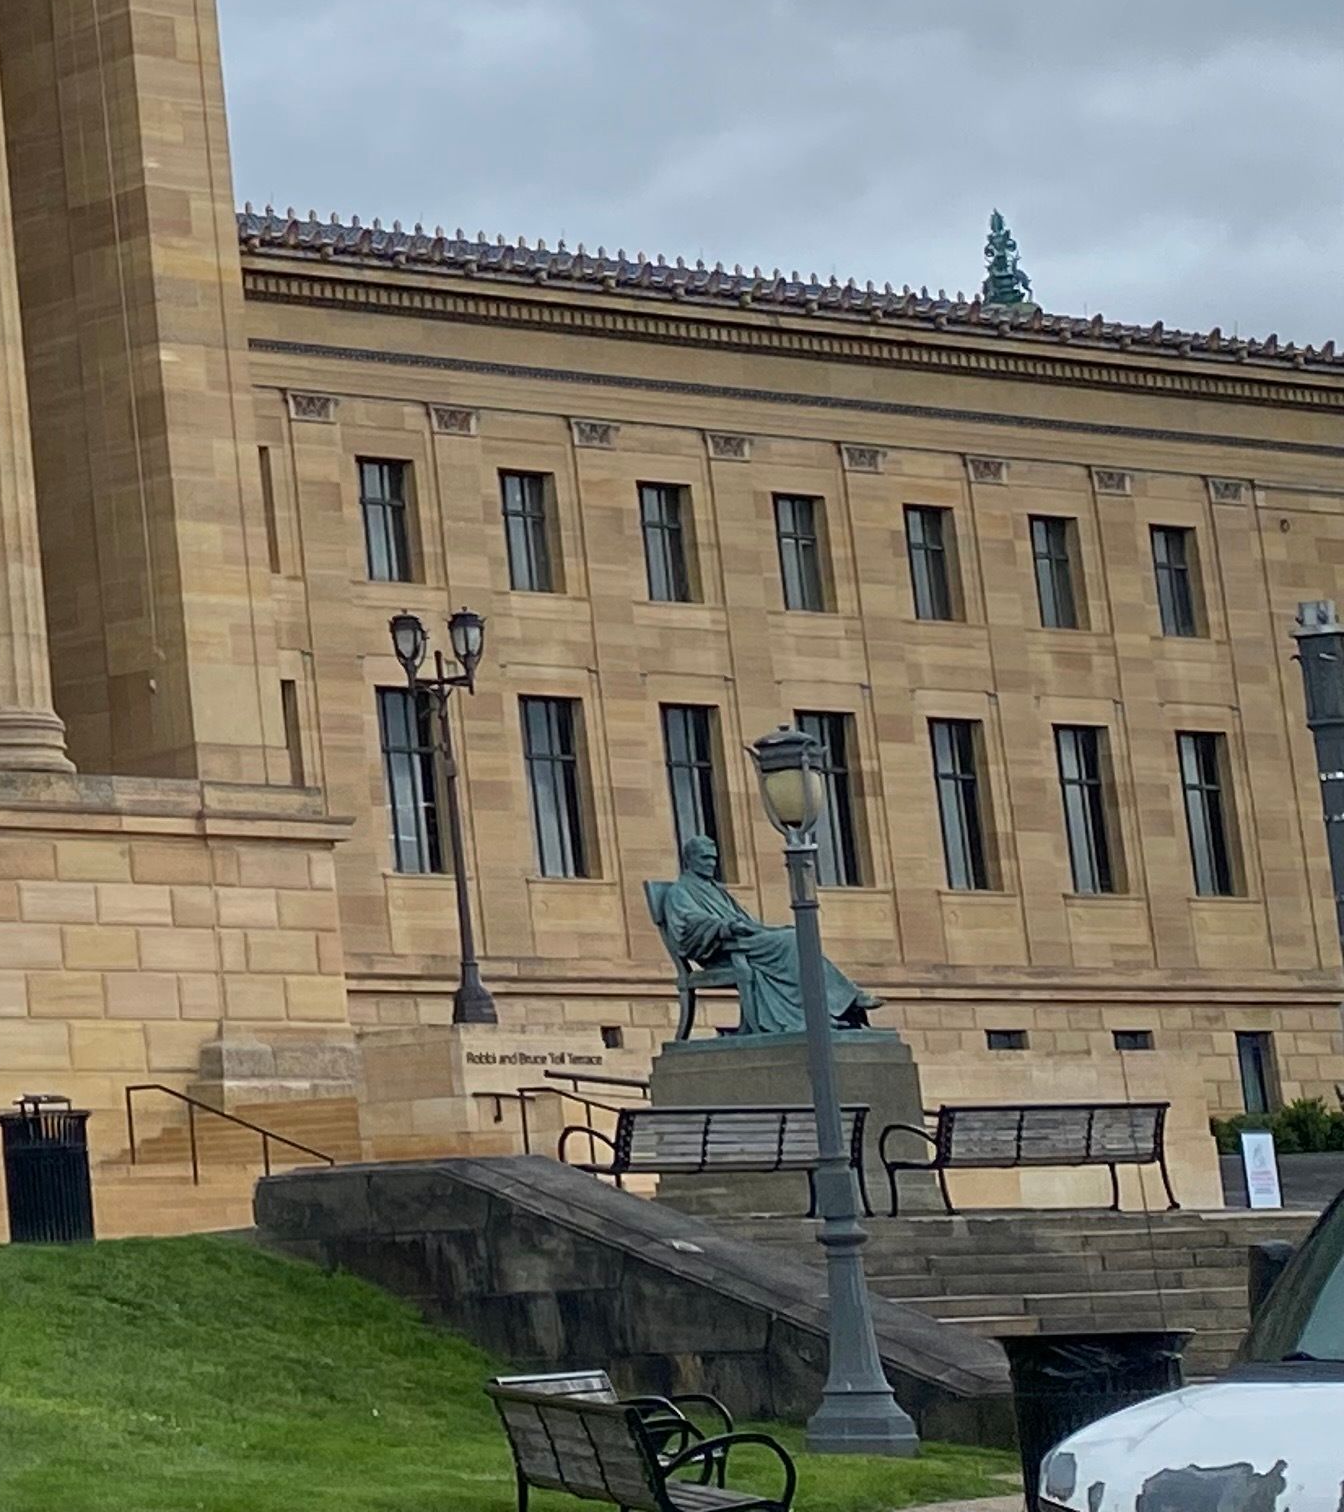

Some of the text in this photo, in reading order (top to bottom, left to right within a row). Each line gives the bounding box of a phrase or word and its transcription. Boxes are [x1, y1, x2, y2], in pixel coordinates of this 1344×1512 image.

[466, 1052, 603, 1065] Robbi and Bruce Toll Terrace
